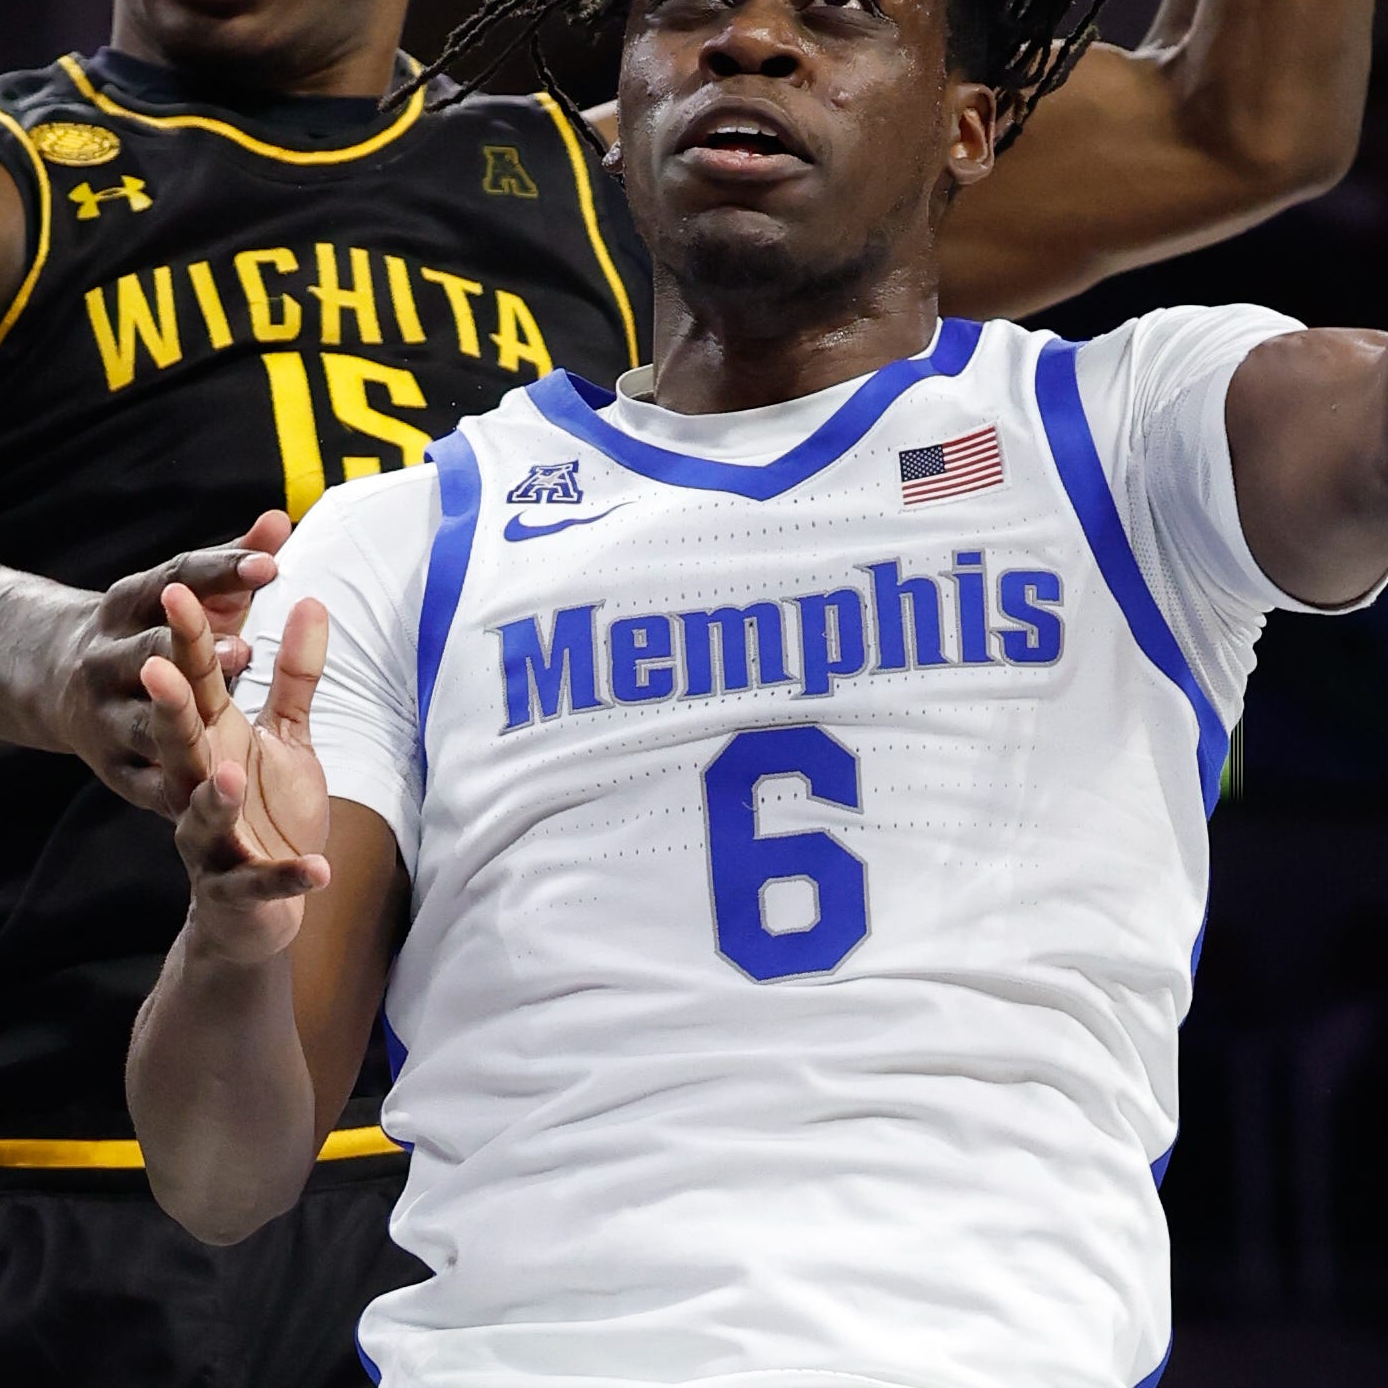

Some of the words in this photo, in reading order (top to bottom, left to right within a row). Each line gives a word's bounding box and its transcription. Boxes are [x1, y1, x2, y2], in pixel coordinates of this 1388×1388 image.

[84, 242, 554, 393] WICHITA
[262, 351, 433, 523] 15
[483, 547, 1065, 735] Memphis
[700, 720, 873, 985] 6
